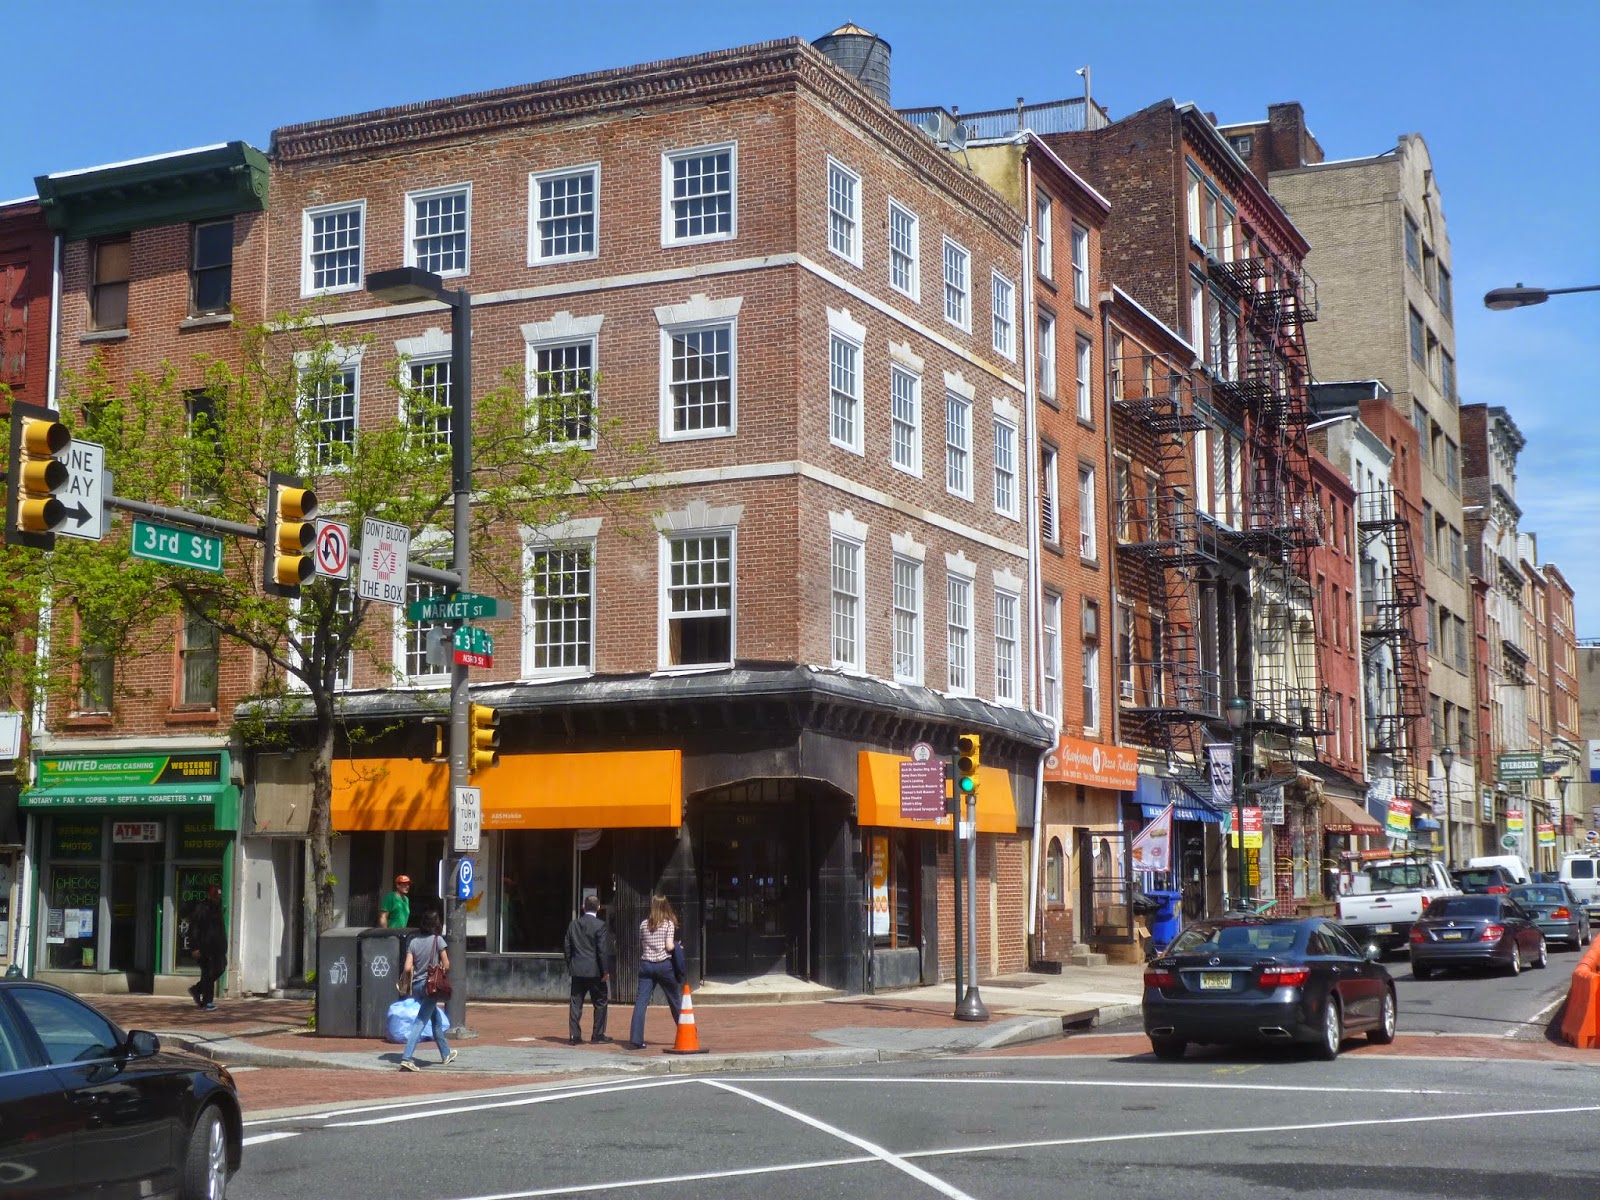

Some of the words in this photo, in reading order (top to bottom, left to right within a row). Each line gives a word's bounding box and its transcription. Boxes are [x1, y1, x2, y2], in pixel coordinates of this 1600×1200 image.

[65, 476, 94, 498] AY
[386, 526, 408, 544] BLOCK
[144, 526, 179, 554] 3rd
[190, 536, 212, 561] St
[362, 580, 380, 597] THE
[384, 584, 402, 601] BOX
[422, 602, 468, 618] MARKET
[473, 606, 483, 616] ST
[482, 640, 492, 654] St
[57, 760, 98, 772] UNITED
[123, 762, 154, 770] CASHING
[170, 761, 210, 770] WESTERN
[1500, 761, 1538, 770] EVERGREEN
[462, 793, 474, 805] NO
[461, 808, 476, 819] TURN
[116, 824, 142, 836] ATM
[464, 822, 473, 832] ON
[462, 836, 474, 846] RED
[56, 878, 100, 889] CHECKS
